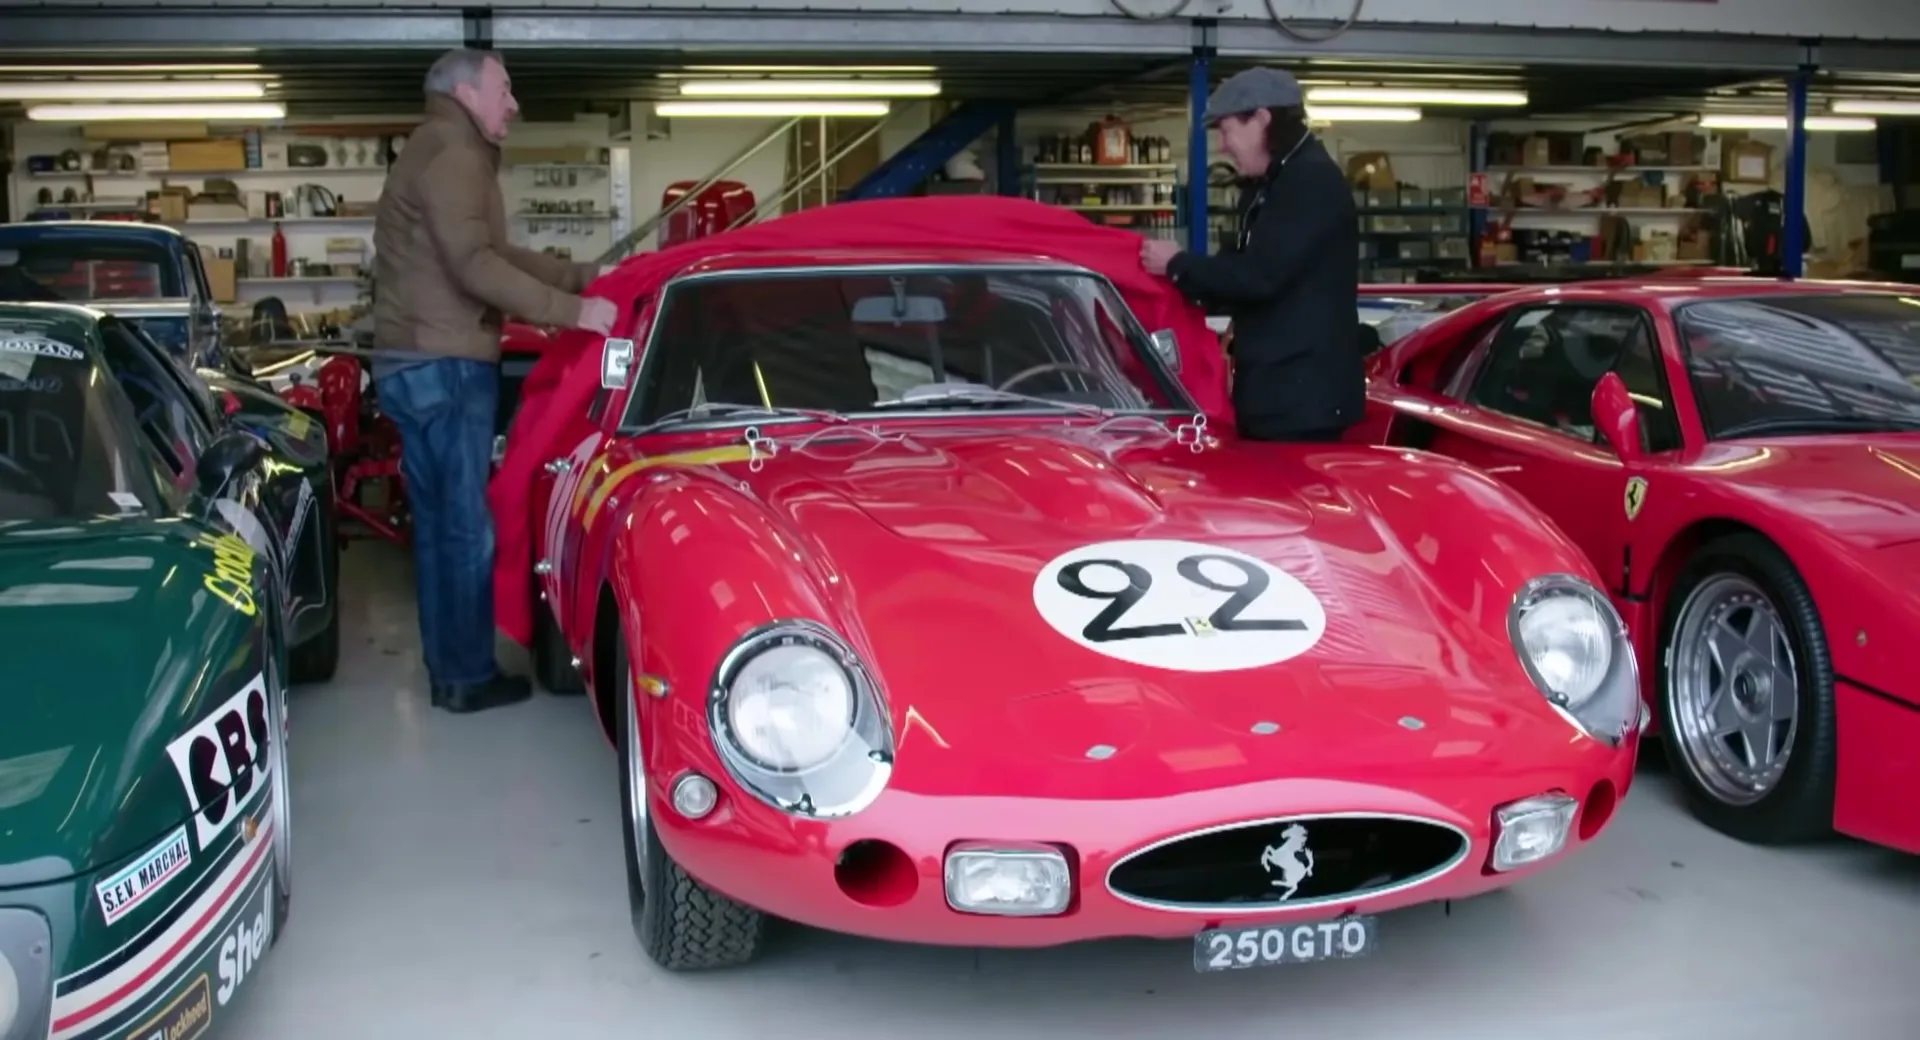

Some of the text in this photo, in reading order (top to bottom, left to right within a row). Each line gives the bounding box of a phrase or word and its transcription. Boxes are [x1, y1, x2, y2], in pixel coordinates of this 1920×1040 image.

[1056, 553, 1310, 643] 22
[188, 689, 269, 826] CBS
[103, 837, 188, 913] S.E.V. MARCHAL
[217, 877, 273, 1006] Shell
